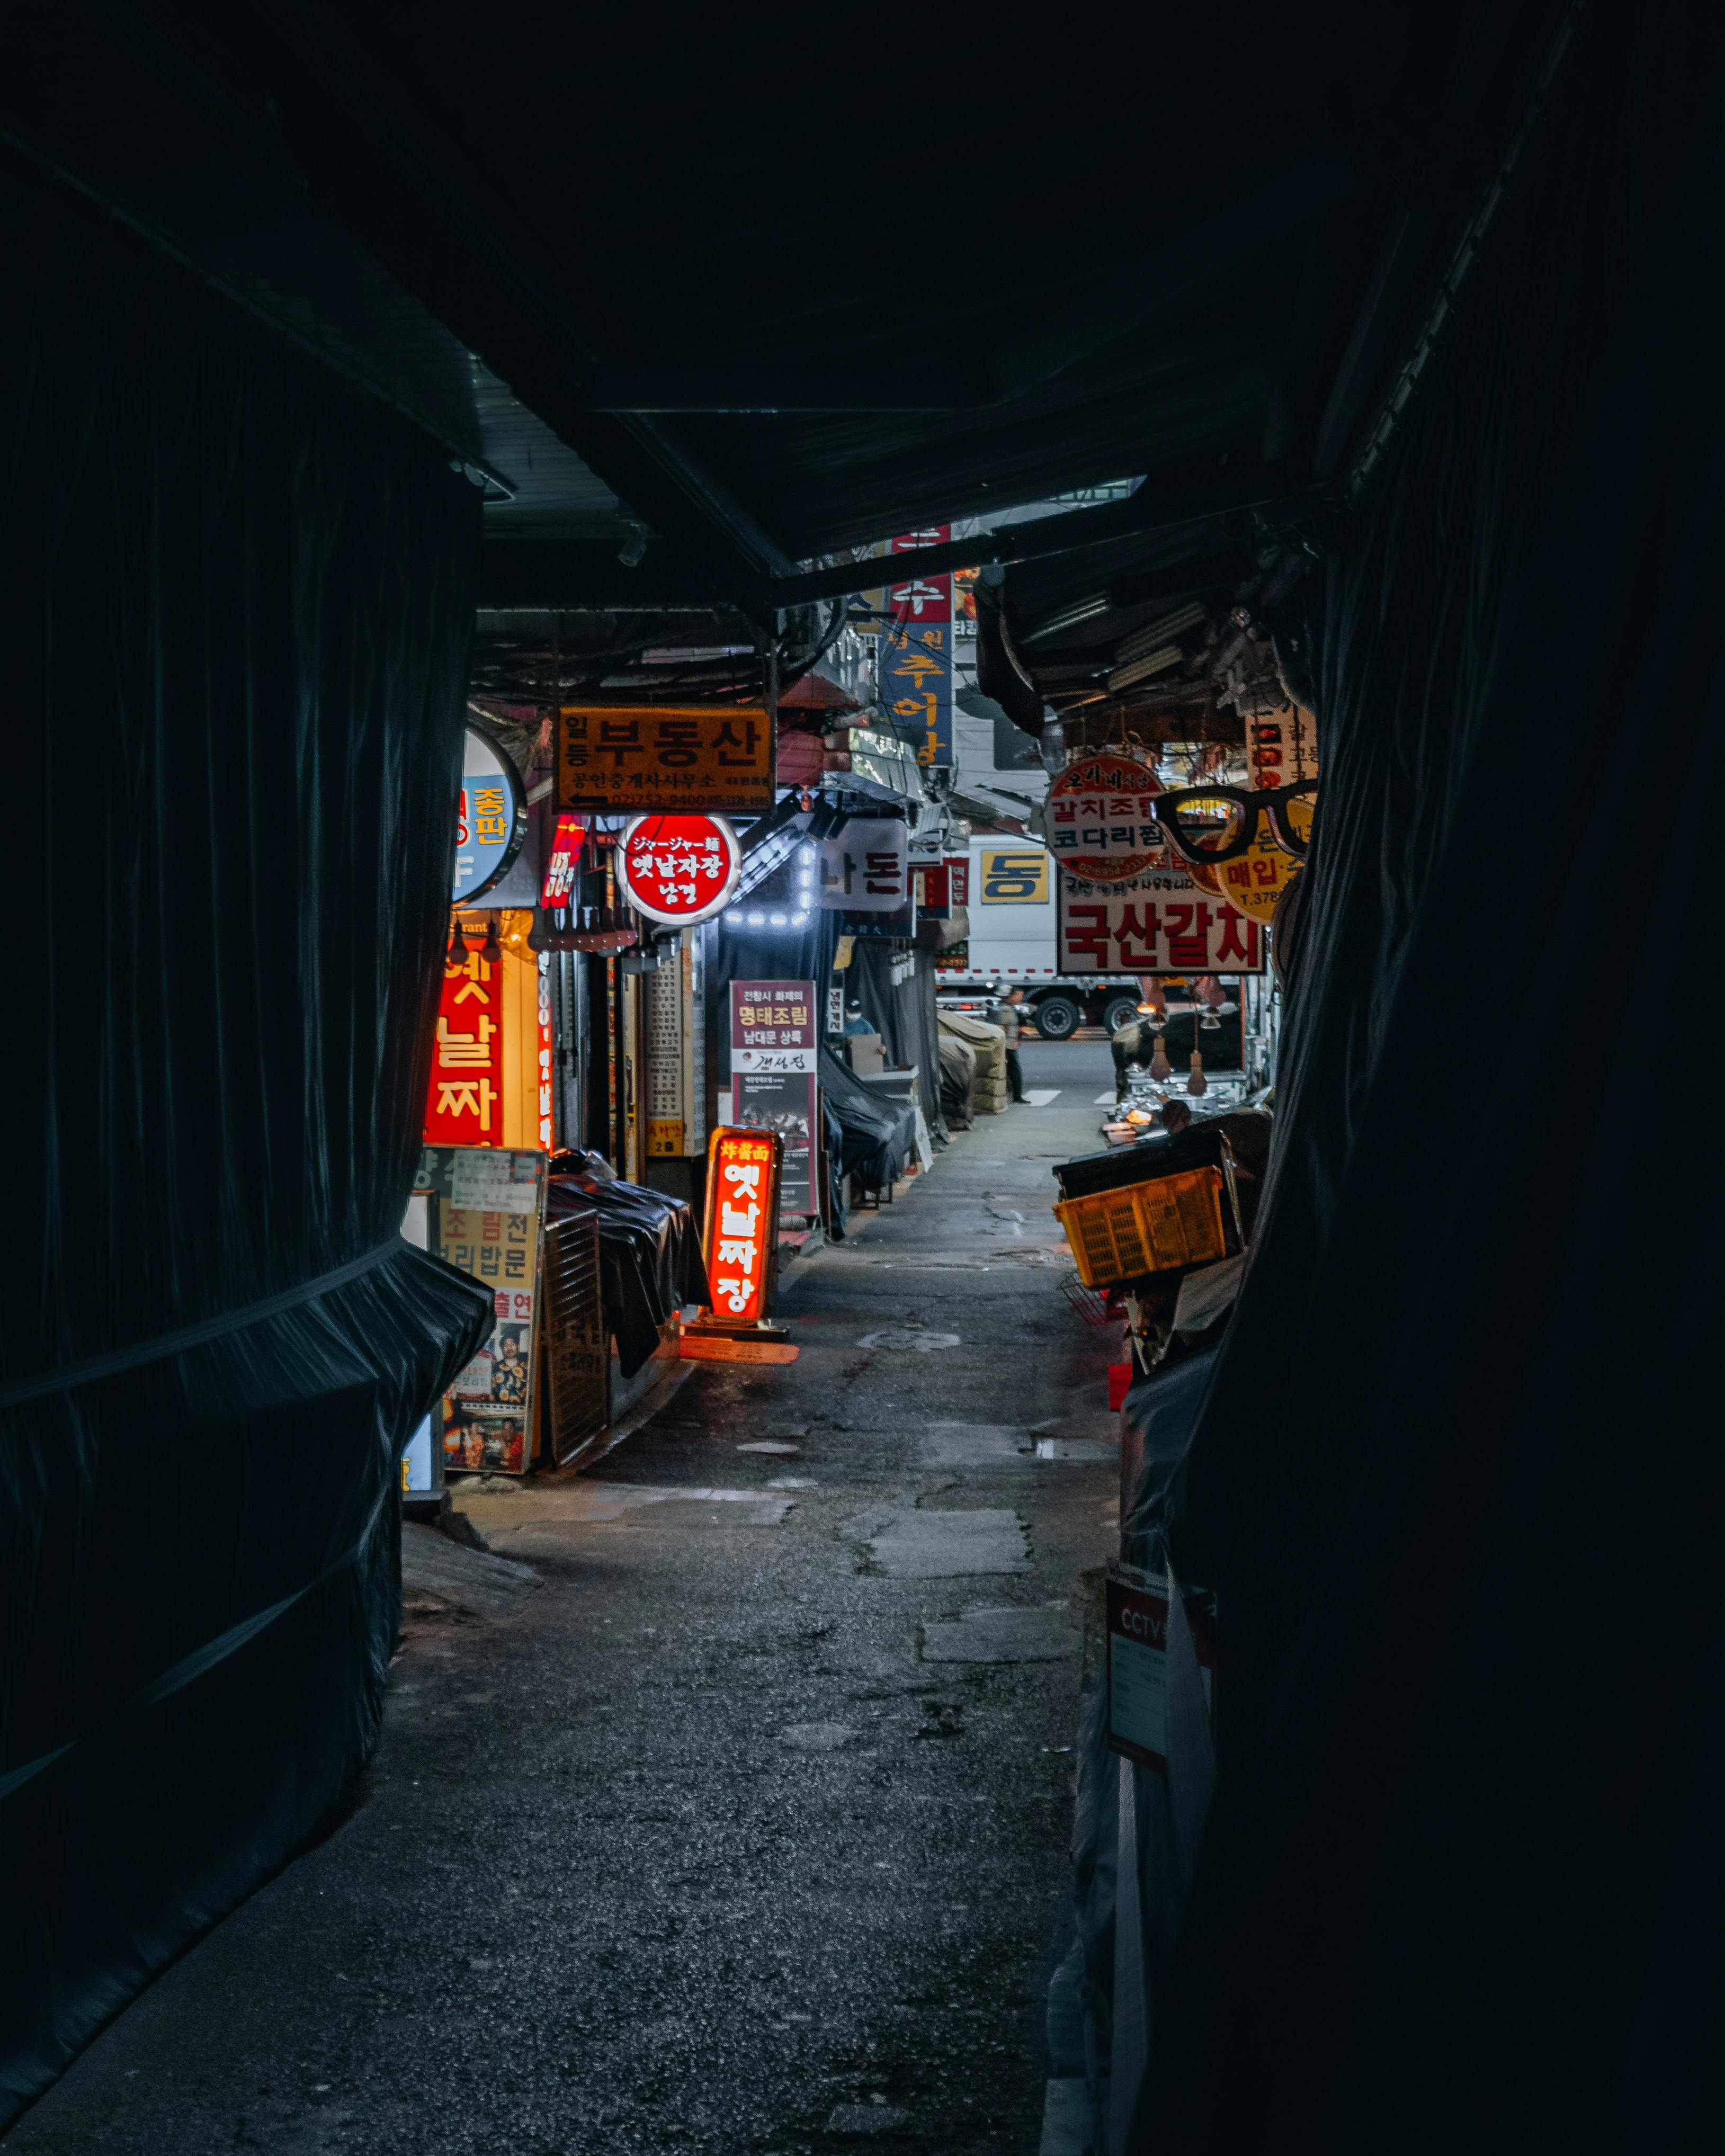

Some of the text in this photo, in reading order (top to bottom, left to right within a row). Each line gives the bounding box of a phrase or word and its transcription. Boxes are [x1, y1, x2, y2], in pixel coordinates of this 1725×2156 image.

[565, 716, 589, 767] 일등
[595, 720, 761, 767] 부동산
[572, 772, 717, 789] 공인중개사사무소
[1053, 825, 1164, 849] 코다리찜
[632, 854, 723, 879] 옛날자장
[1066, 902, 1260, 969] 국산갈치
[739, 1006, 808, 1026] 명태조림
[744, 1030, 776, 1045] 남대문
[717, 1164, 761, 1312] 옛날짜장
